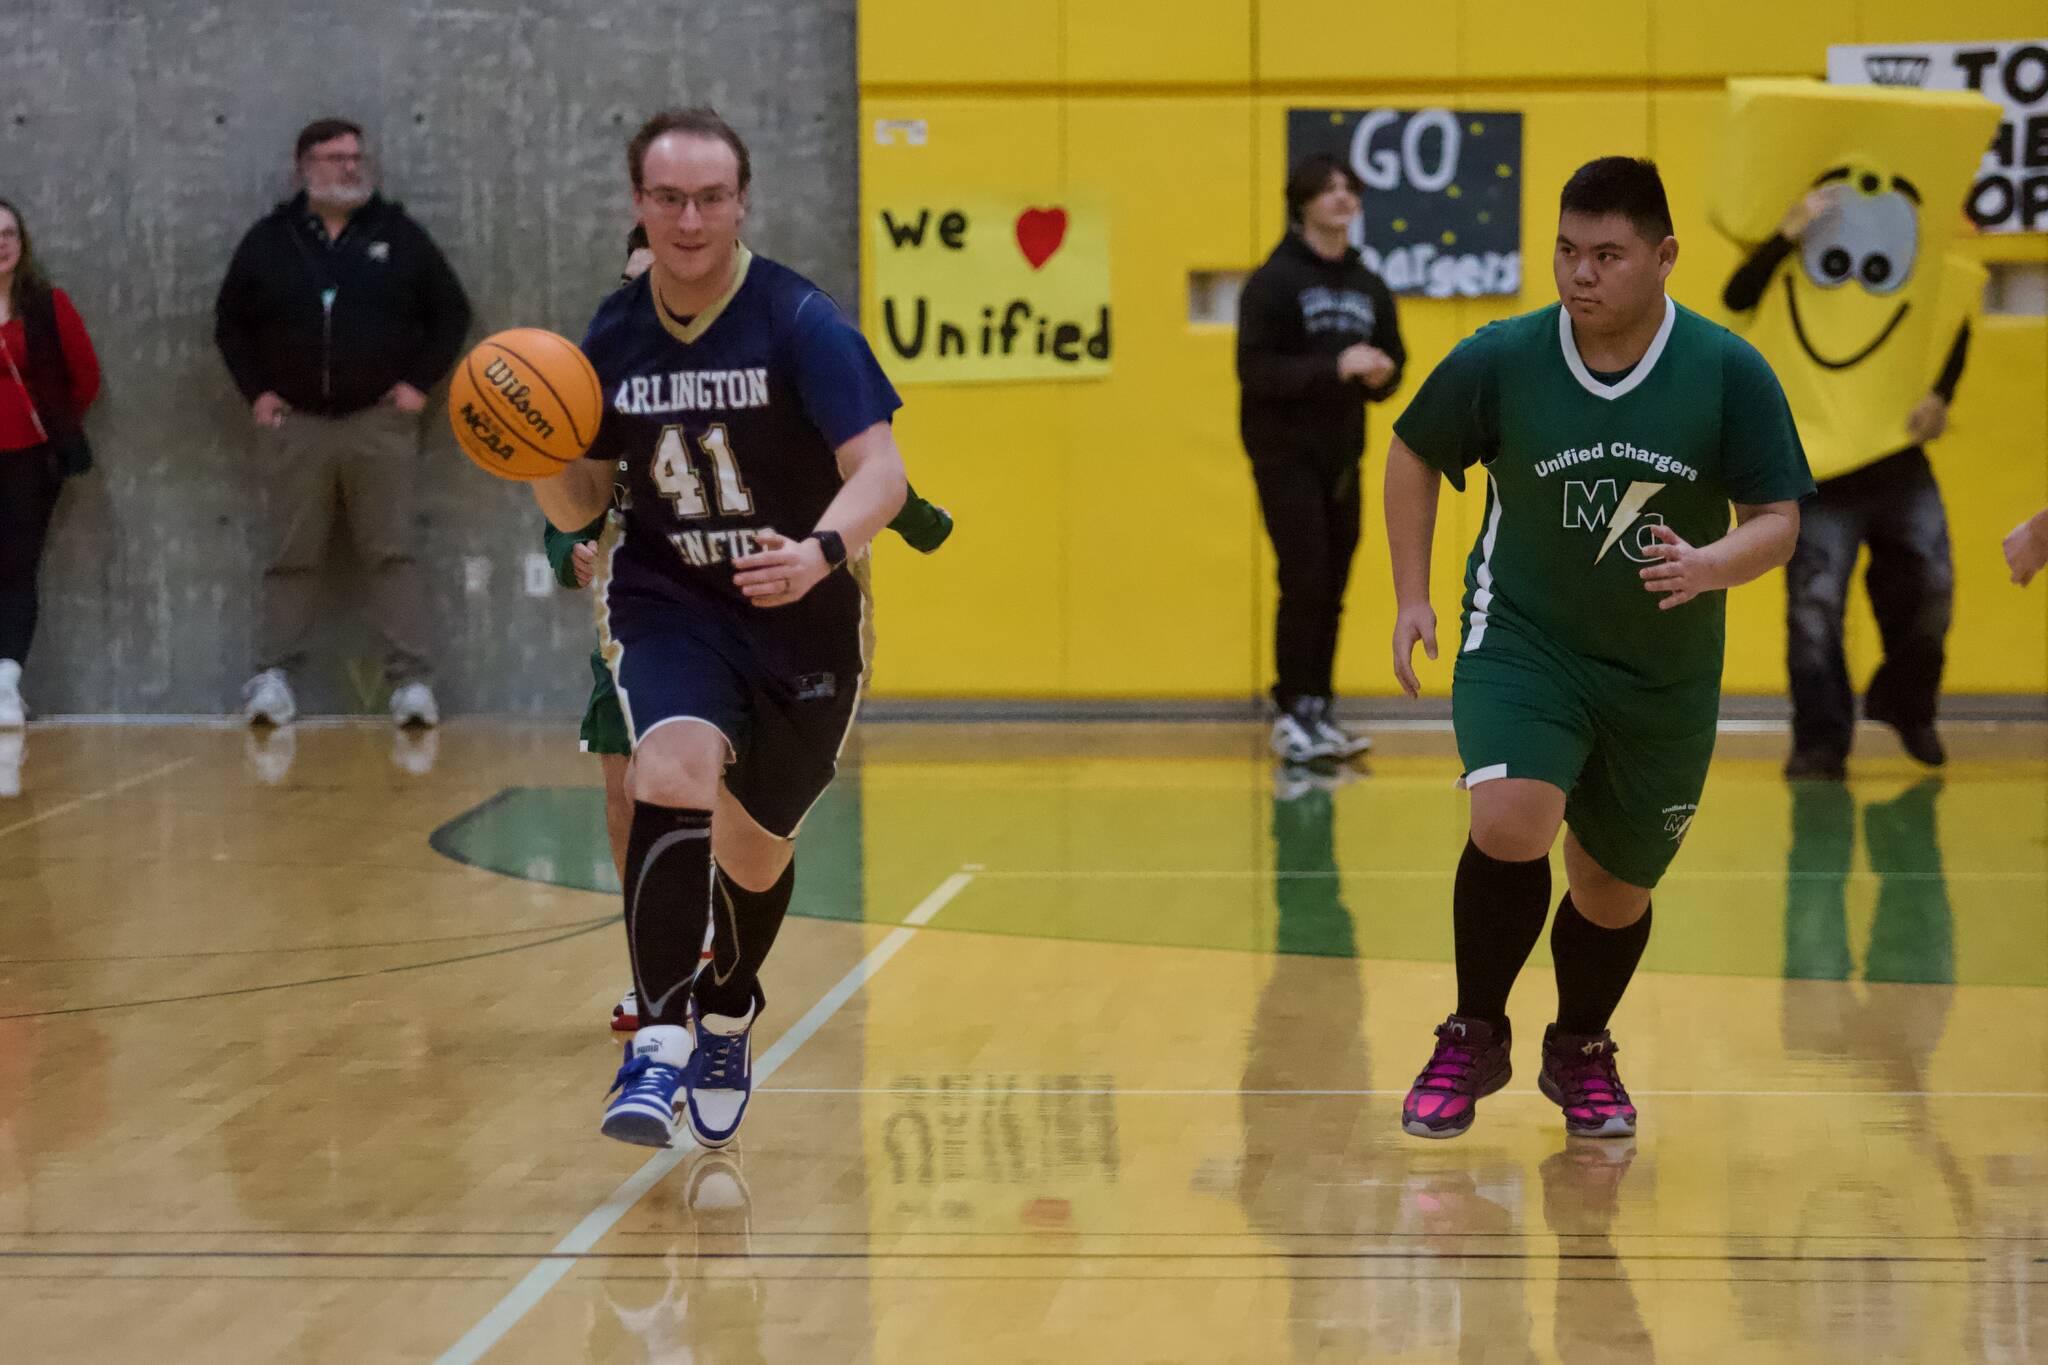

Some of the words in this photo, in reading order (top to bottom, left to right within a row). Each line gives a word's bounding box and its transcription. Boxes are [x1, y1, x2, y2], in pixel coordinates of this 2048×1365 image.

[1955, 46, 2048, 105] TO
[1350, 108, 1460, 193] GO
[1964, 175, 2048, 229] OP
[884, 297, 1112, 361] Unified
[485, 356, 555, 440] Wilson
[614, 368, 769, 415] ARLINGTON
[460, 403, 515, 460] NCAA
[651, 422, 754, 518] 41
[1534, 443, 1604, 478] Unified
[1610, 442, 1698, 482] Chargers
